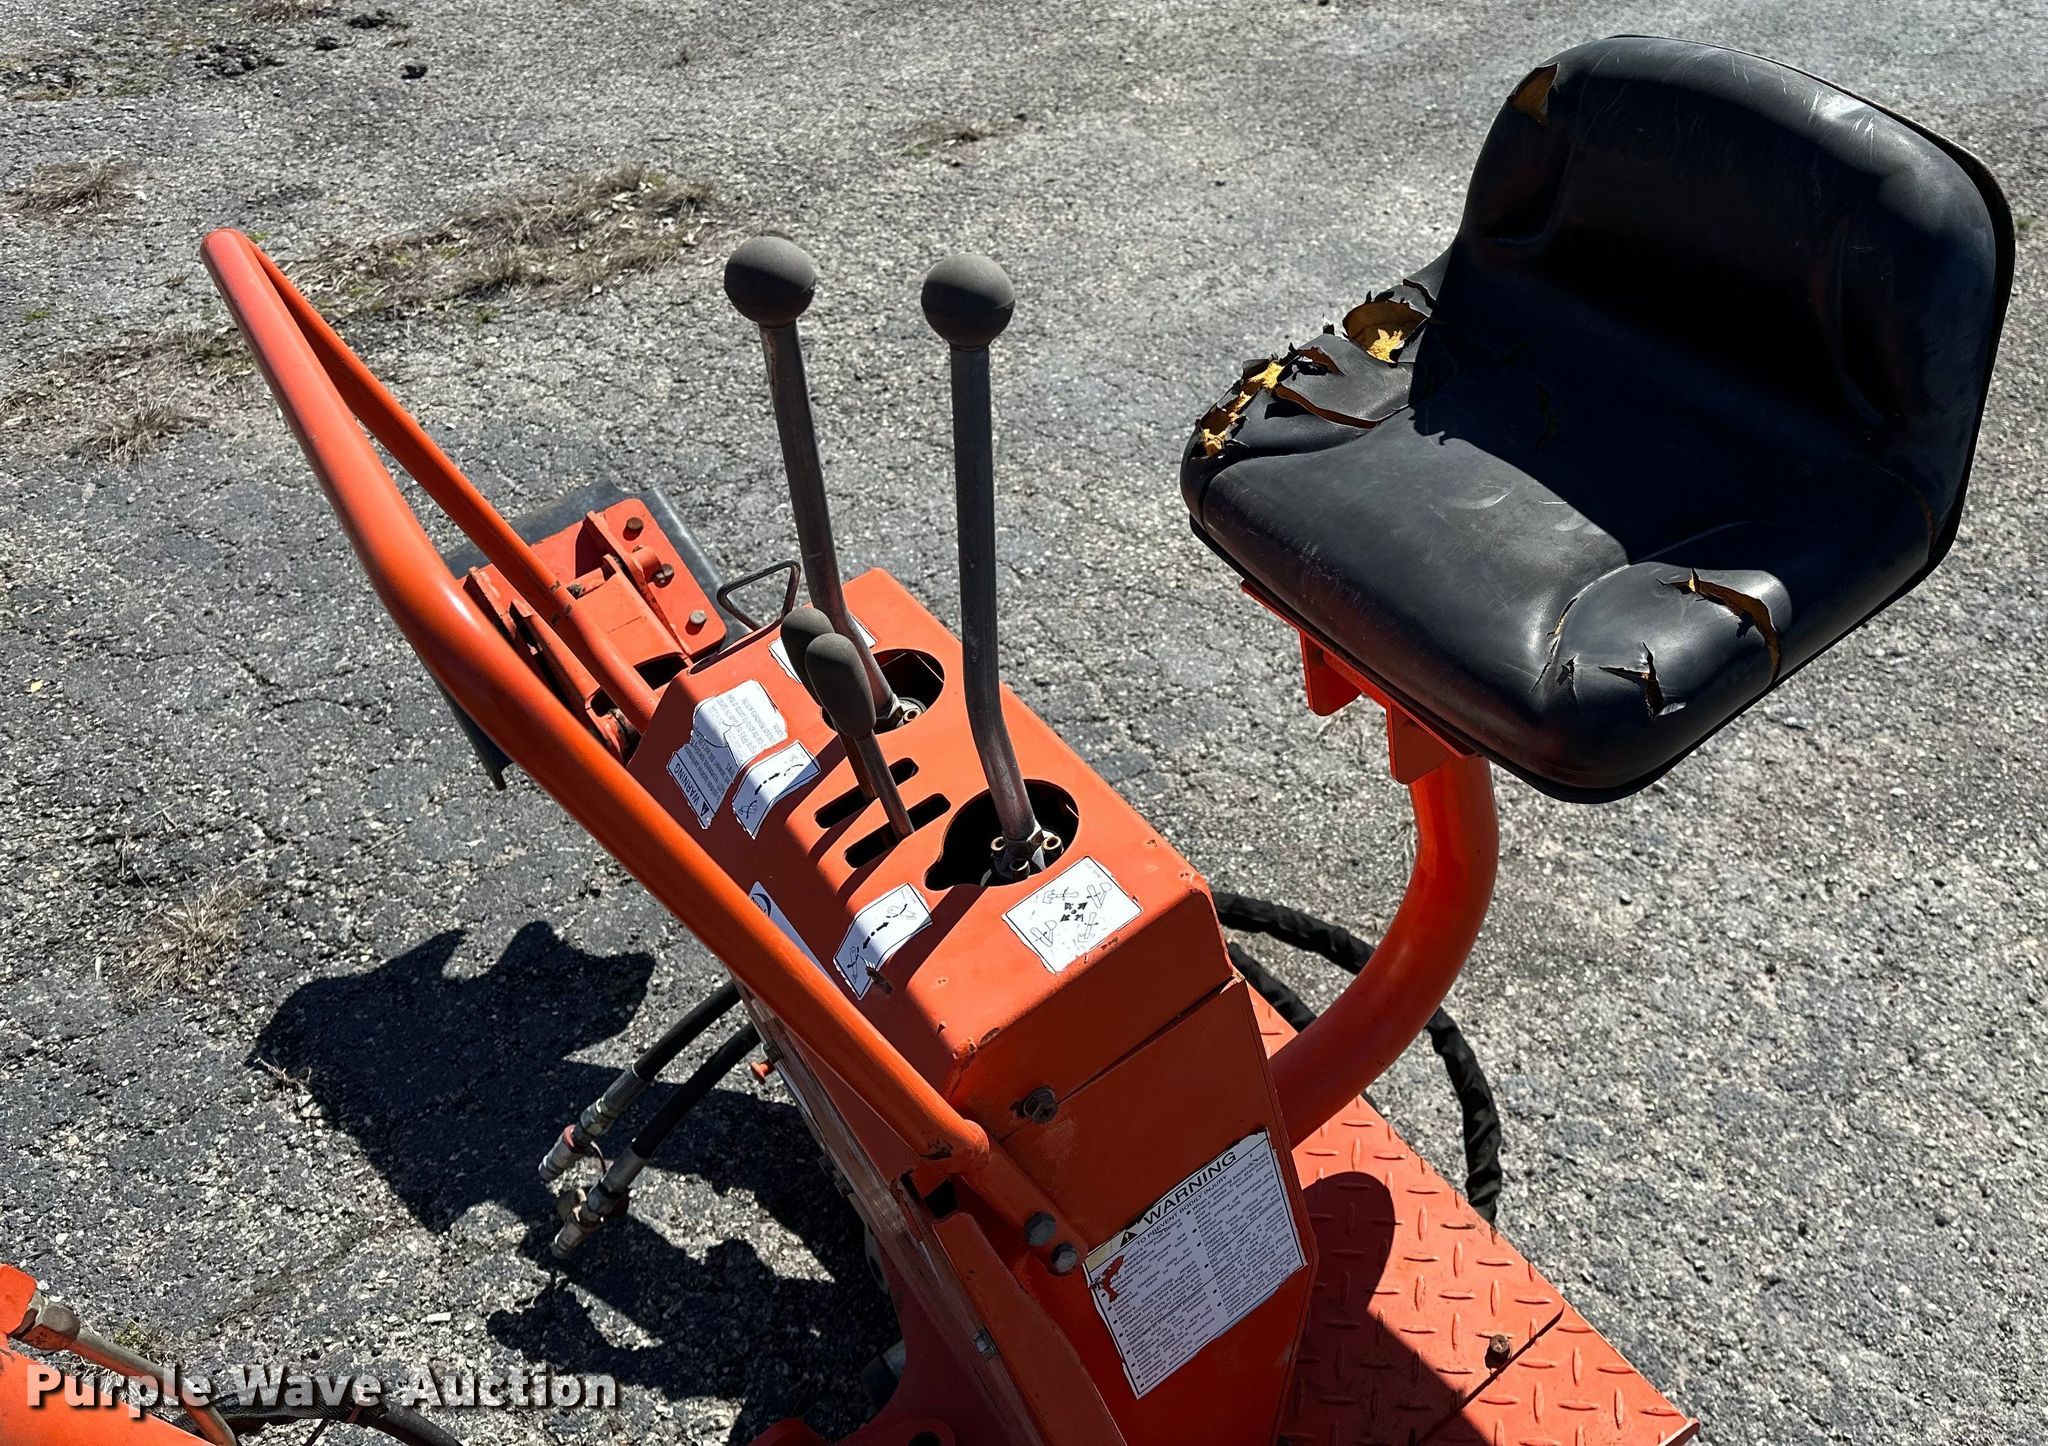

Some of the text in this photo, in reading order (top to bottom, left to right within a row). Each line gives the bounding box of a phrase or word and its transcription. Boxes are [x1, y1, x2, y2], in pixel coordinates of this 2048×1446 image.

[673, 762, 701, 805] WARNING
[1137, 1174, 1227, 1245] TO PREVENT BODILY INJURY
[1143, 1151, 1237, 1225] WARNING
